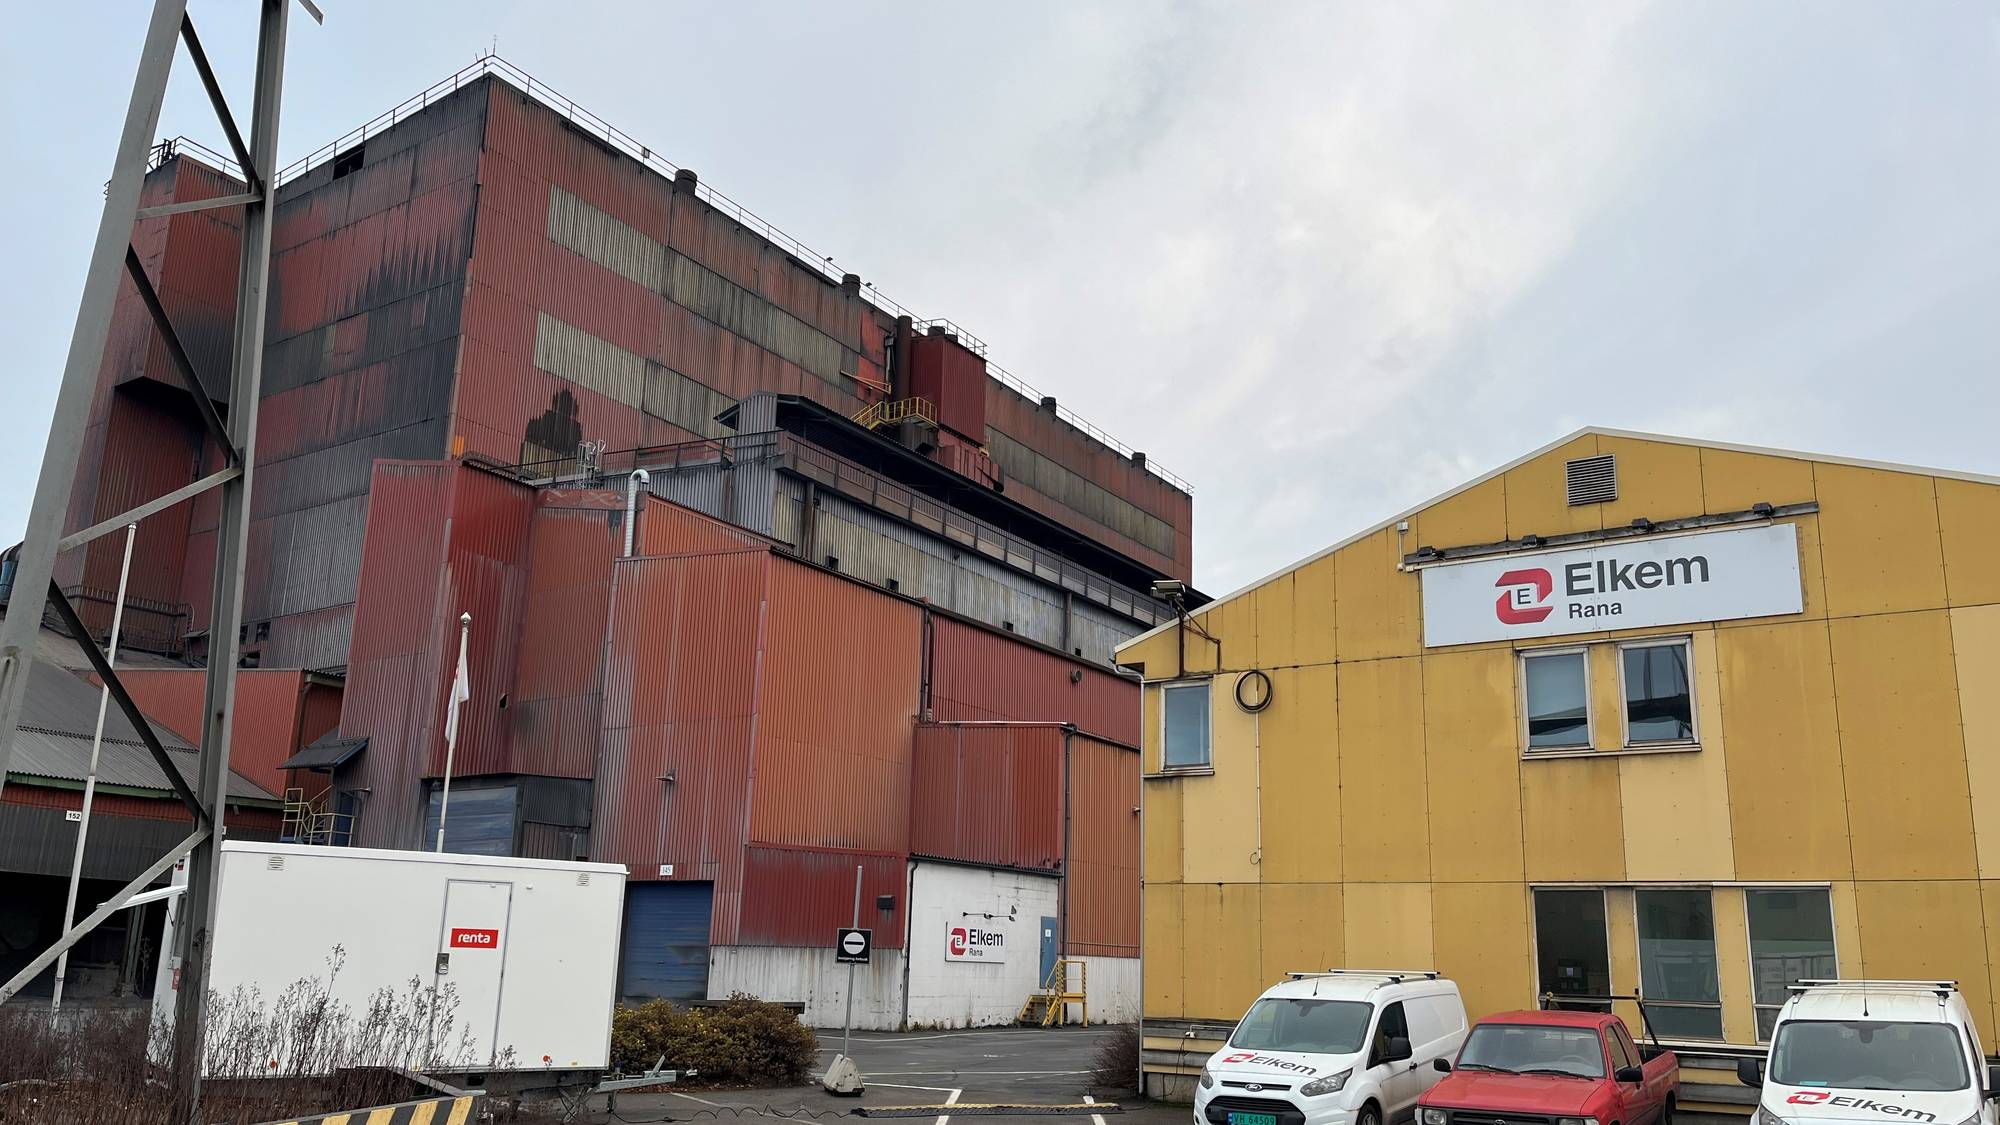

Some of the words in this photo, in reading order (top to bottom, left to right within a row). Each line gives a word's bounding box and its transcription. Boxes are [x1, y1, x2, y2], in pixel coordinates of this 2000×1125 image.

[1517, 588, 1532, 605] E
[1564, 555, 1710, 597] Elkem
[1568, 602, 1623, 619] Rana
[68, 812, 81, 820] 152
[457, 932, 491, 944] renta
[969, 928, 1003, 947] Elkem
[1249, 1056, 1317, 1076] Elkem
[1828, 1096, 1937, 1123] Elkem
[1234, 1114, 1245, 1123] VH
[1248, 1115, 1275, 1125] 64509
